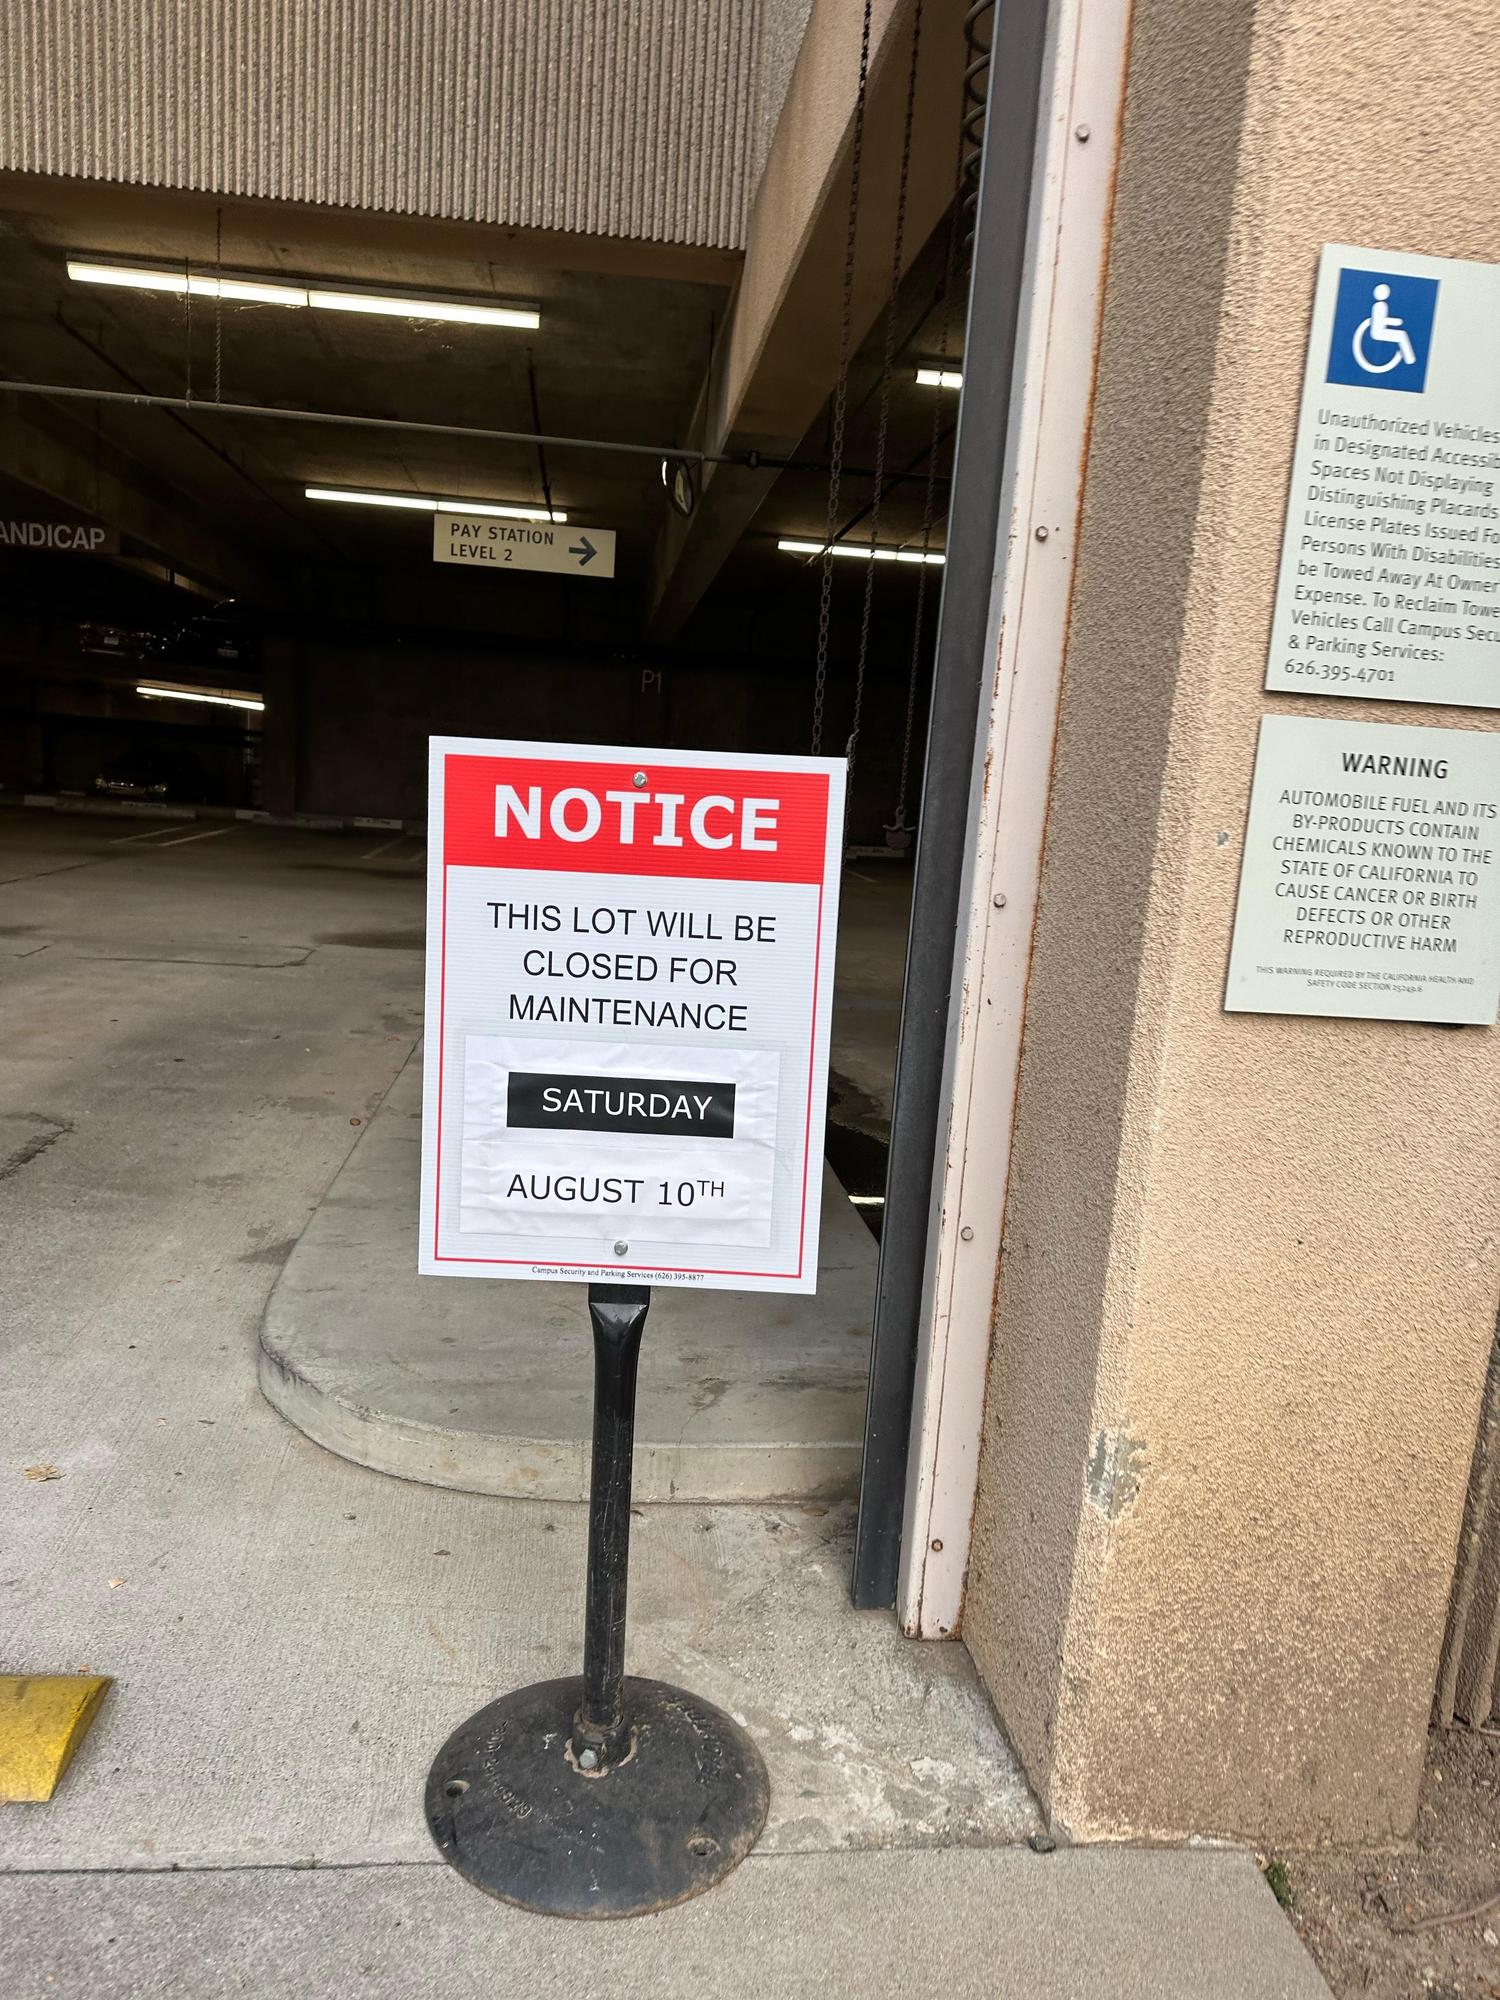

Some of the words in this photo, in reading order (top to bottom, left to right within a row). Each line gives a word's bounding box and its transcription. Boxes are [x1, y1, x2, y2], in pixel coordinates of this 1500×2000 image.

[1318, 409, 1430, 436] Unauthorized
[1433, 421, 1500, 443] Vehicles
[1314, 434, 1329, 450] in
[1334, 436, 1429, 461] Designated
[1310, 459, 1370, 480] Spaces
[1374, 466, 1404, 485] Not
[1408, 470, 1495, 497] Displaying
[1307, 485, 1426, 515] Distinguishing
[1430, 498, 1500, 519] Placards
[450, 523, 482, 538] PAY
[488, 526, 554, 545] STATION
[1304, 510, 1366, 531] License
[1370, 516, 1421, 536] Plates
[1424, 522, 1479, 542] Issued
[450, 543, 497, 560] LEVEL
[504, 549, 513, 562] 2
[1301, 535, 1366, 556] Persons
[1370, 542, 1408, 560] With
[1411, 546, 1500, 569] Disabilities
[1297, 560, 1318, 577] be
[1322, 562, 1375, 582] Towed
[1376, 568, 1423, 590] Away
[1424, 573, 1445, 589] At
[1294, 584, 1367, 606] Expense.
[1372, 592, 1390, 608] To
[1394, 594, 1458, 614] Reclaim
[1291, 609, 1358, 630] Vehicles
[1362, 616, 1394, 633] Call
[1397, 619, 1462, 640] Campus
[1287, 635, 1299, 649] &
[1305, 635, 1368, 658] Parking
[1371, 641, 1445, 661] Services:
[641, 669, 662, 695] P1
[1284, 658, 1395, 683] 626.395-4701
[1342, 752, 1449, 779] WARNING
[493, 784, 780, 852] NOTICE
[1279, 789, 1387, 812] AUTOMOBILE
[1391, 797, 1430, 814] FUEL
[1433, 800, 1469, 817] AND
[1472, 803, 1498, 819] ITS
[1292, 813, 1405, 836] BY-PRODUCTS
[1408, 821, 1480, 841] CONTAIN
[1272, 835, 1367, 857] CHEMICALS
[1370, 842, 1433, 861] KNOWN
[1436, 846, 1458, 862] TO
[1462, 846, 1493, 865] THE
[1280, 859, 1329, 877] STATE
[1333, 862, 1355, 878] OF
[1358, 864, 1453, 885] CALIFORNIA
[1458, 870, 1479, 887] TO
[1275, 882, 1329, 900] CAUSE
[1333, 885, 1398, 905] CANCER
[1402, 890, 1425, 906] OR
[1429, 892, 1478, 909] BIRTH
[486, 902, 561, 932] THIS
[573, 907, 637, 936] LOT
[646, 910, 723, 941] WILL
[734, 915, 777, 943] BE
[1296, 906, 1366, 925] DEFECTS
[1370, 911, 1394, 927] OR
[1398, 913, 1452, 930] OTHER
[1283, 929, 1406, 951] REPRODUCTIVE
[1409, 935, 1458, 953] HARM
[522, 949, 659, 982] CLOSED
[670, 957, 738, 987] FOR
[1256, 966, 1274, 975] THIS
[1276, 967, 1313, 976] WARNING
[1314, 968, 1353, 979] REQUIRED
[1355, 970, 1365, 979] BY
[1367, 971, 1381, 980] THE
[1382, 972, 1427, 983] CALIFORNIA
[1428, 975, 1457, 985] HEALTH
[1458, 976, 1475, 985] AND
[1307, 978, 1335, 988] SAFETY
[1336, 980, 1356, 989] CODE
[1359, 981, 1391, 991] SECTION
[508, 993, 748, 1032] MAINTENANCE
[541, 1087, 713, 1120] SATURDAY
[506, 1174, 644, 1205] AUGUST
[657, 1180, 726, 1208] 10TH
[531, 1266, 558, 1275] Campus
[560, 1267, 586, 1276] Security
[600, 1269, 625, 1279] Parking
[626, 1271, 654, 1279] Services
[654, 1272, 672, 1281] (626)
[673, 1273, 705, 1281] 395-8877
